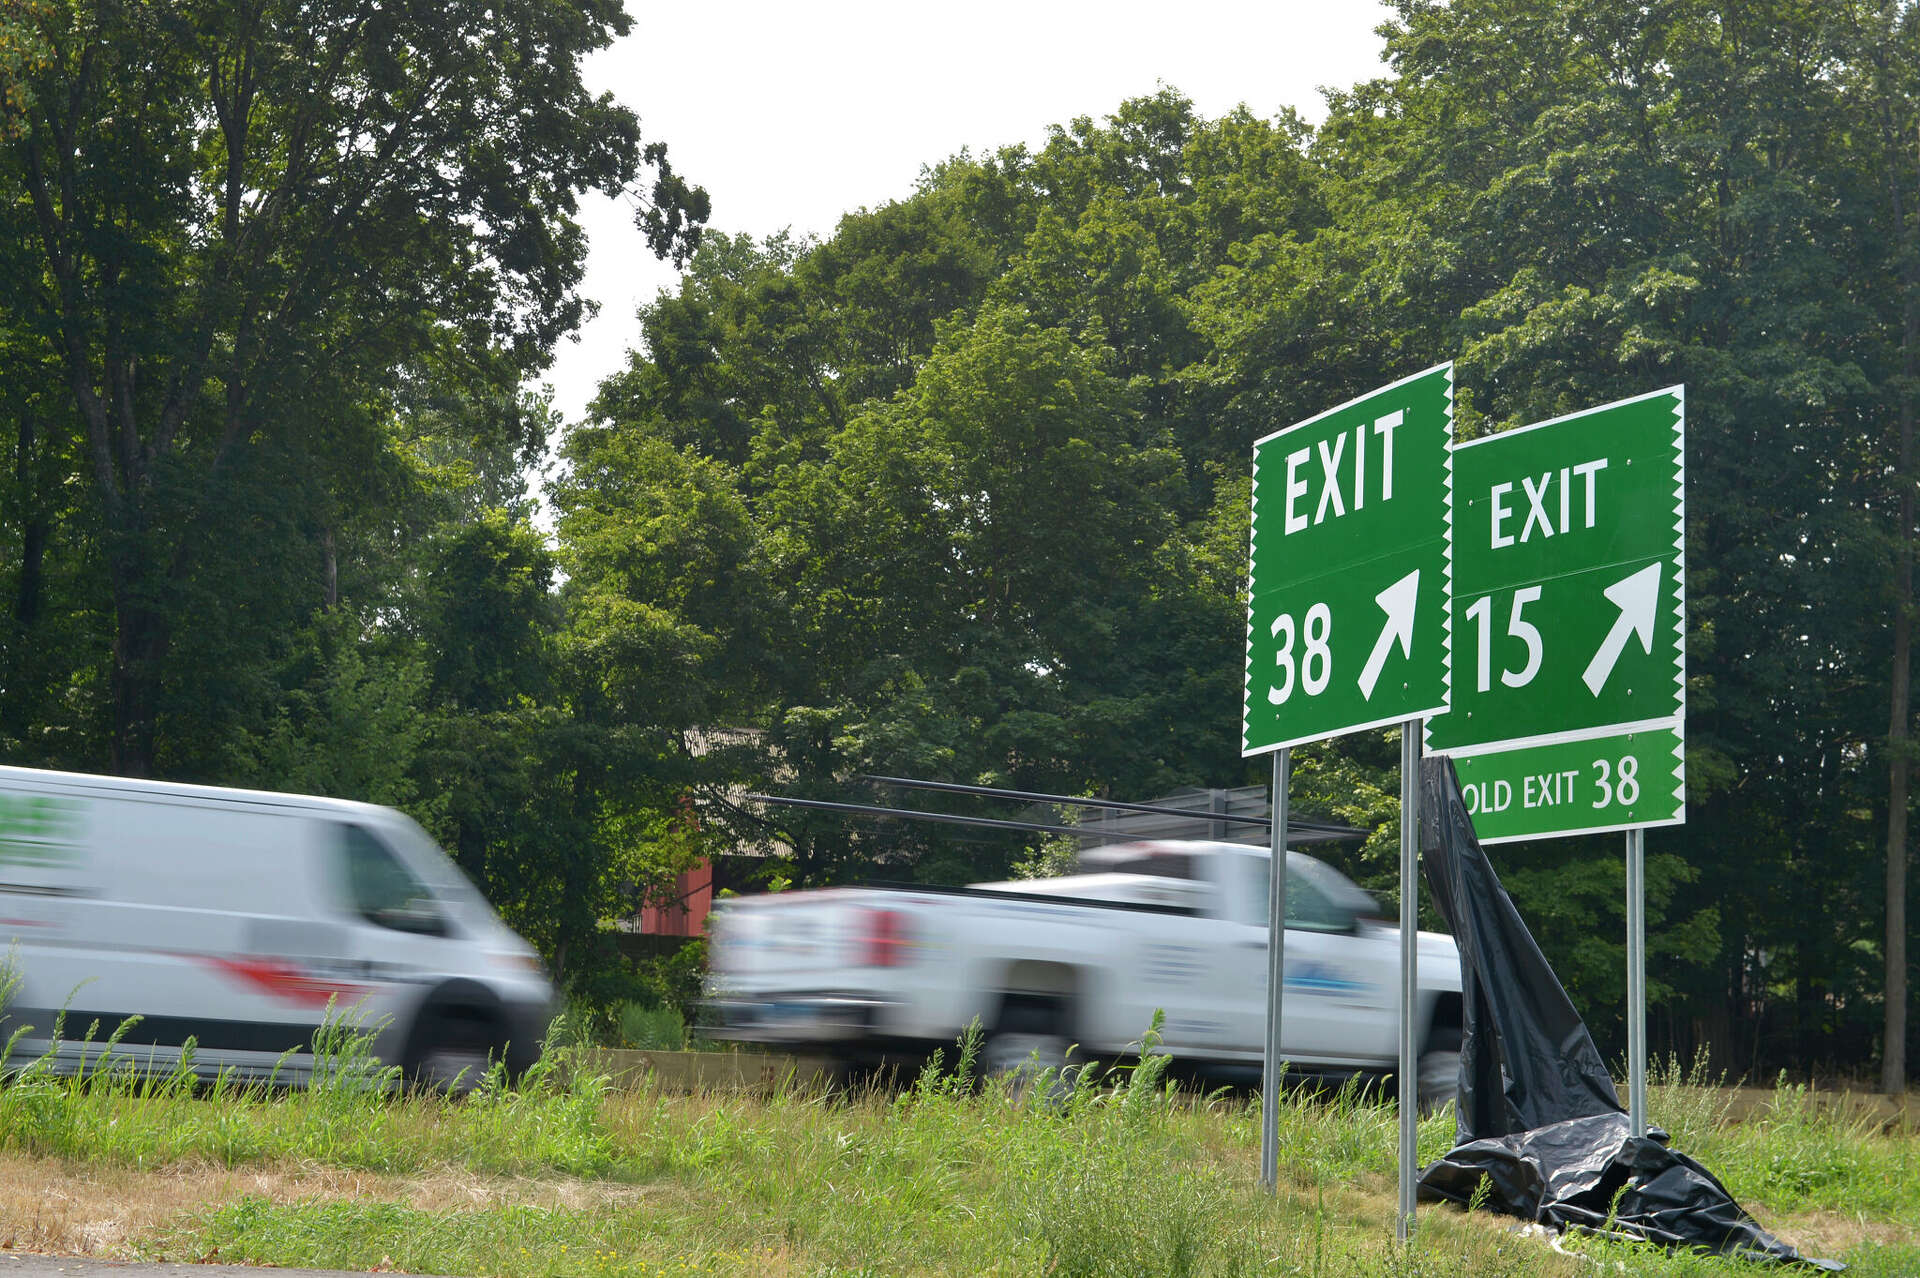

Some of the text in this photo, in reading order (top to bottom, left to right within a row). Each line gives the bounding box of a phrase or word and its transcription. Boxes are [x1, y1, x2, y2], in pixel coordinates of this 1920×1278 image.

[1285, 410, 1404, 536] EXIT
[1491, 458, 1608, 550] EXIT
[1267, 602, 1332, 705] 38
[1465, 585, 1544, 693] 15
[1462, 755, 1640, 815] OLD EXIT 38
